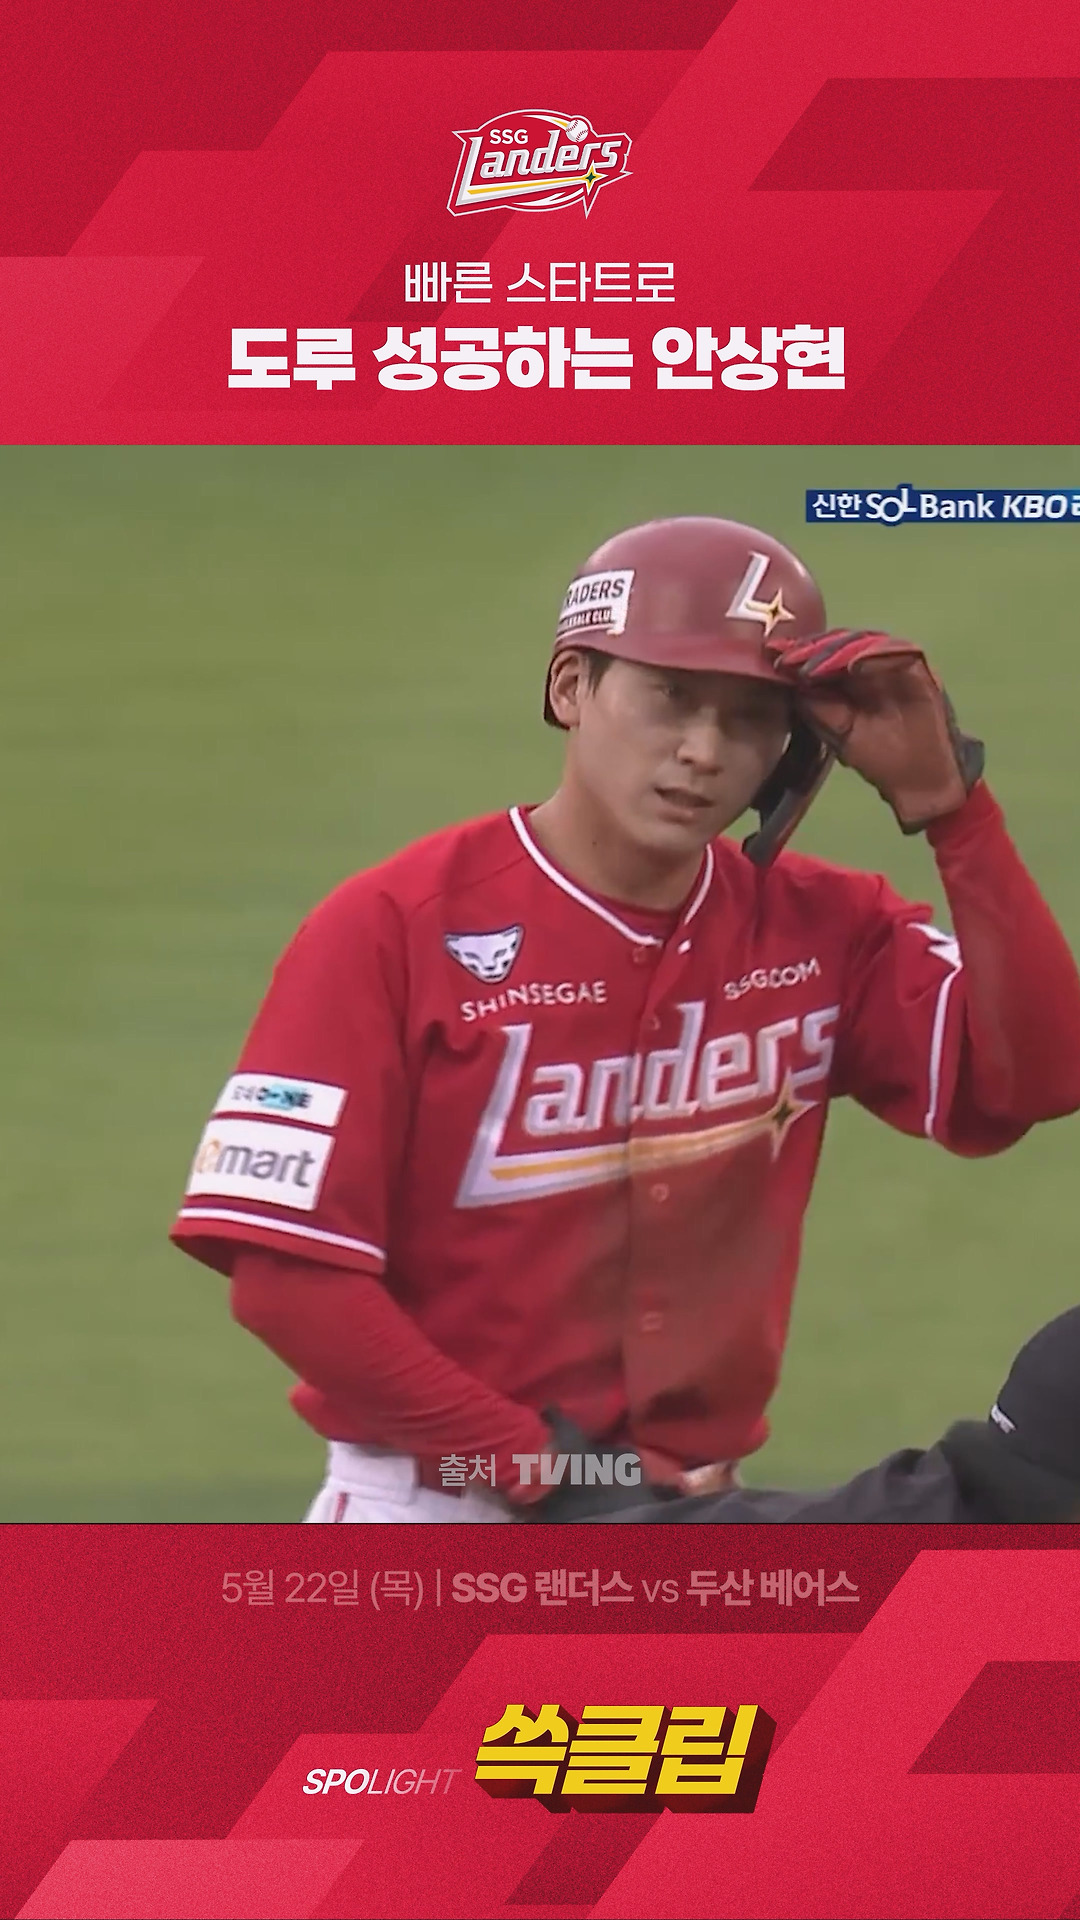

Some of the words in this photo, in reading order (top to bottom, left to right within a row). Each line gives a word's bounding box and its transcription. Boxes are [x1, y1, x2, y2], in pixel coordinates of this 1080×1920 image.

[565, 578, 625, 608] RADERS
[461, 980, 607, 1022] SHINSEGAE
[453, 999, 841, 1209] Landers
